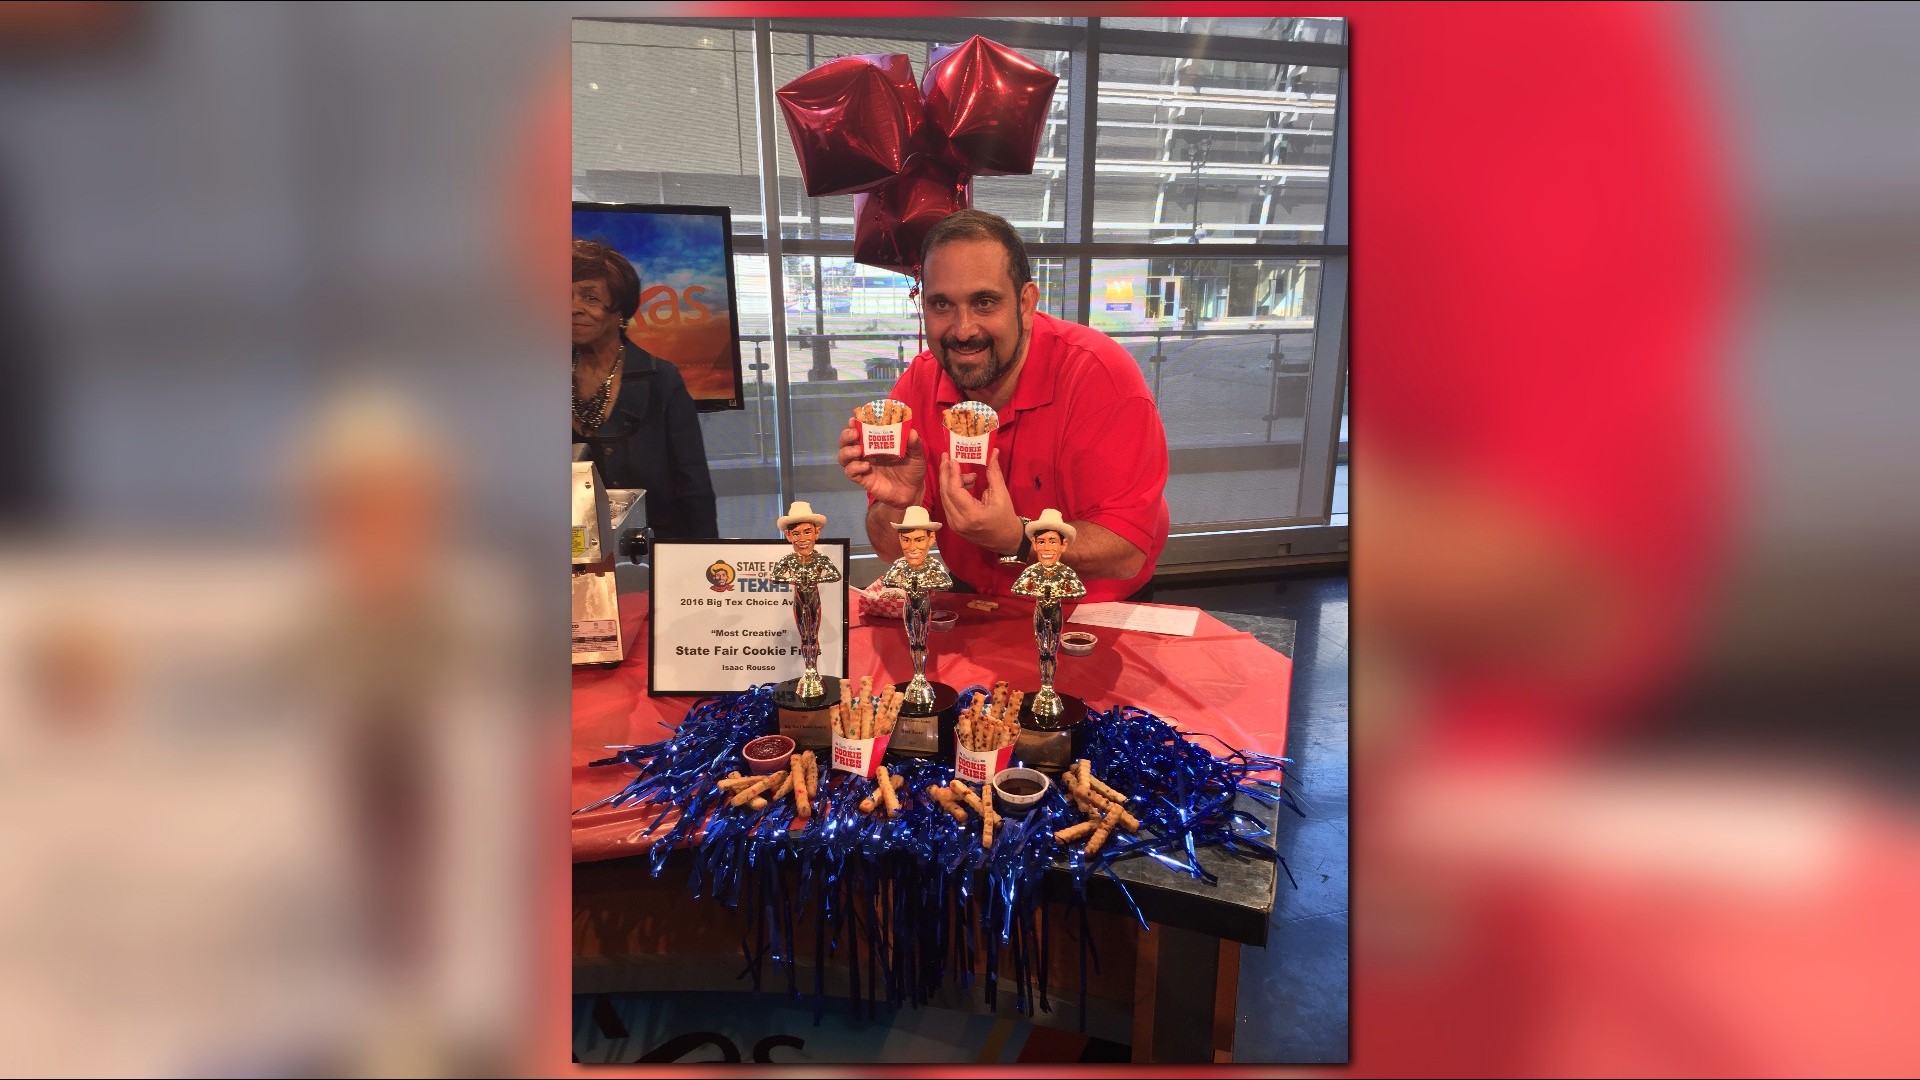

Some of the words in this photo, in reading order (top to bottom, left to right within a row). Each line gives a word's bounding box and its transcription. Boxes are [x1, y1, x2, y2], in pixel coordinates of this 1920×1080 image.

[955, 452, 981, 460] FRIES
[737, 562, 765, 571] STATE
[707, 599, 722, 607] Big
[676, 646, 710, 656] State
[714, 646, 739, 656] Fair
[743, 646, 786, 656] Cookie
[835, 746, 861, 759] COOKIE
[834, 754, 861, 768] FRIES
[958, 756, 986, 771] COOKIE
[958, 764, 986, 780] FRIES
